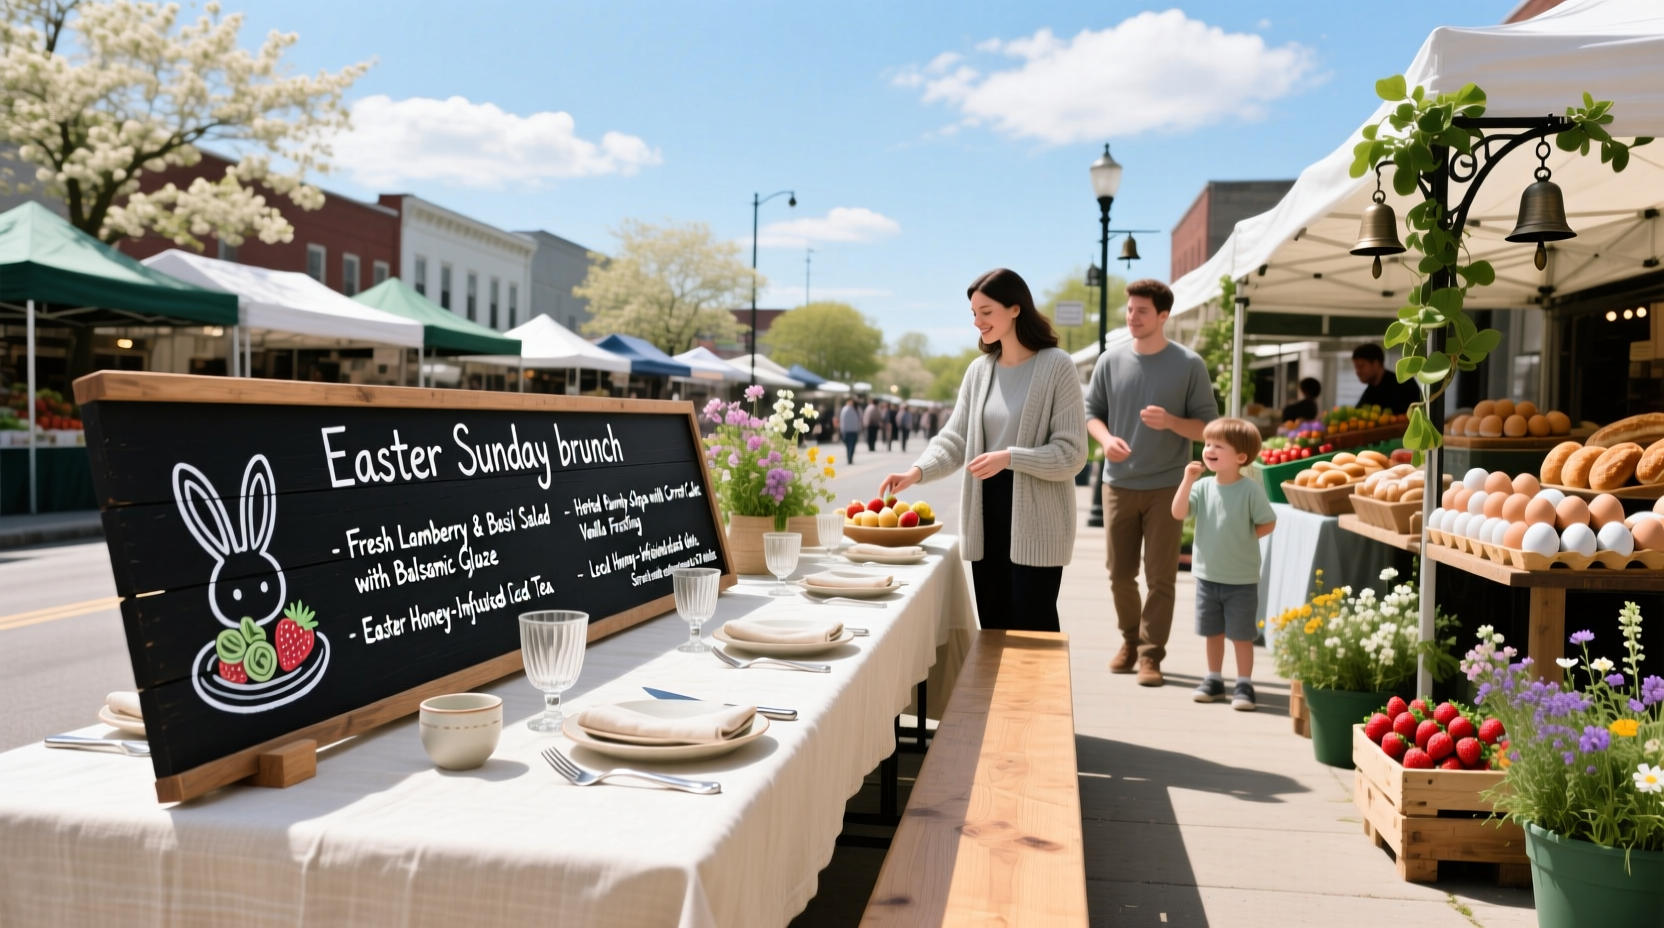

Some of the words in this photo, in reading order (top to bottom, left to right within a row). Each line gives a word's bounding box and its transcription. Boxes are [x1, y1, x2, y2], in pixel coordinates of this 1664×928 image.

[321, 425, 442, 489] Easter
[452, 422, 551, 490] Sunday
[553, 423, 624, 468] brunch
[345, 525, 395, 559] Fresh
[472, 514, 484, 538] &
[518, 502, 551, 530] Salad
[354, 562, 391, 594] with
[361, 614, 407, 645] Easter
